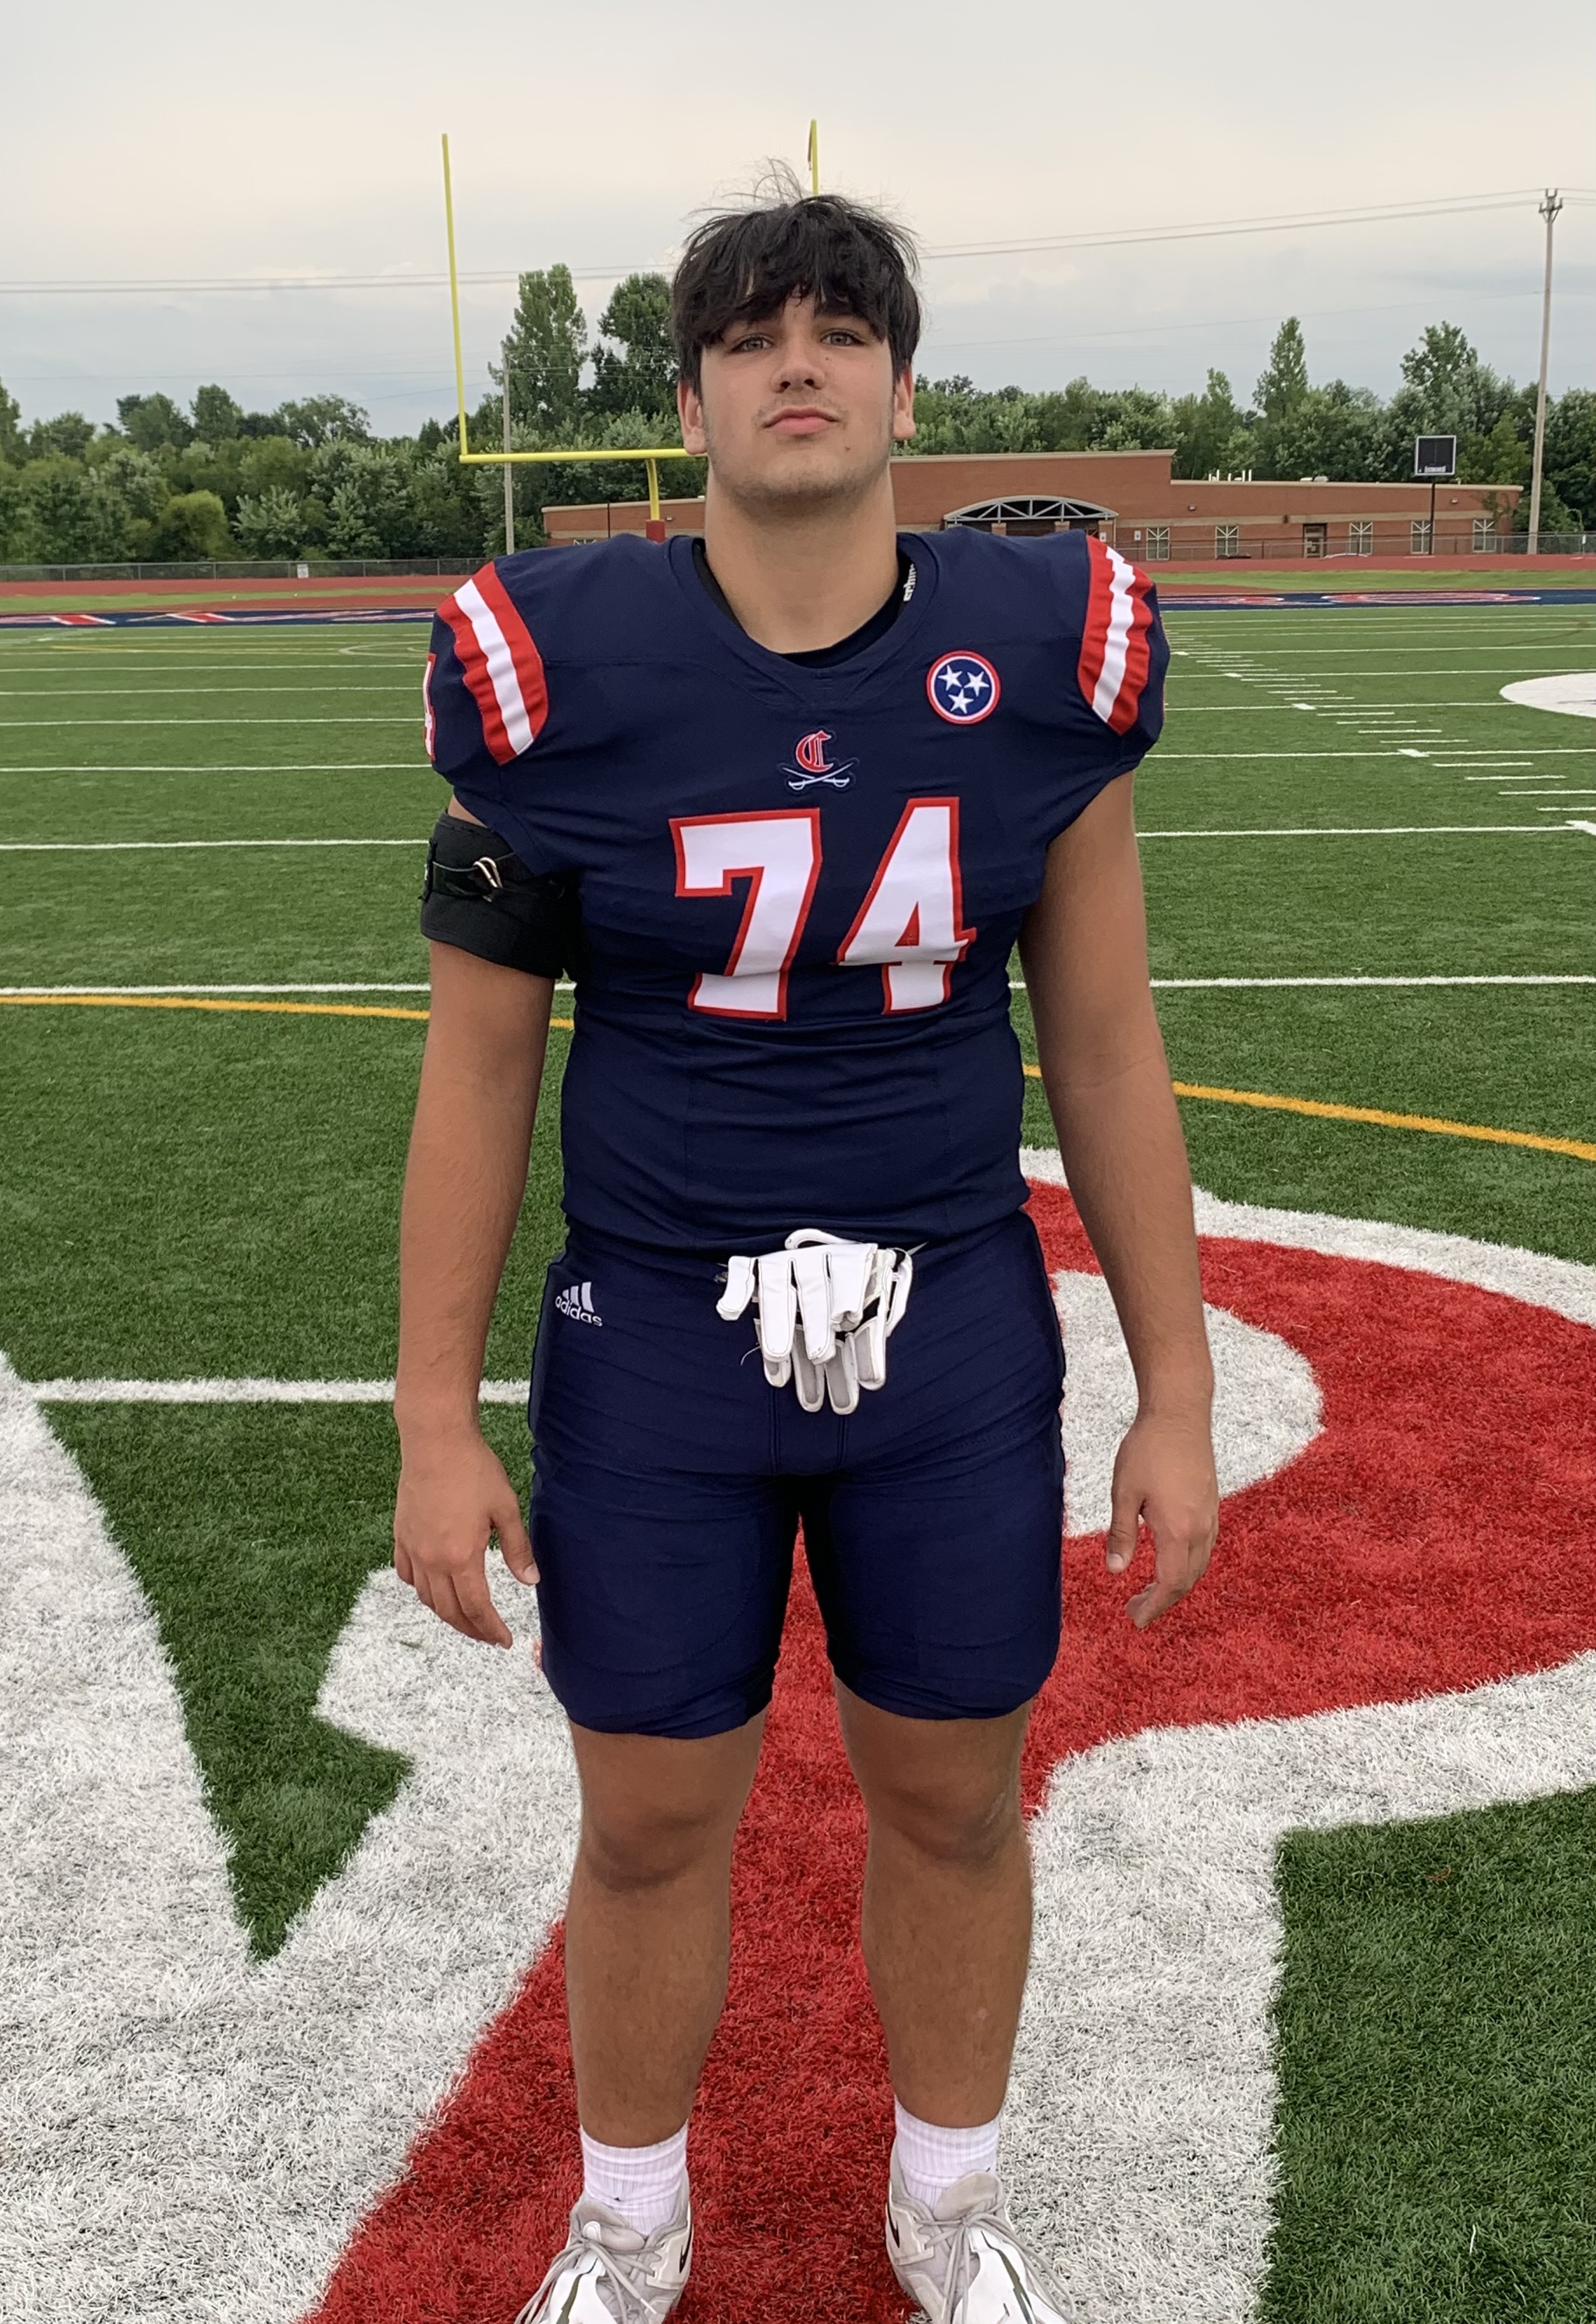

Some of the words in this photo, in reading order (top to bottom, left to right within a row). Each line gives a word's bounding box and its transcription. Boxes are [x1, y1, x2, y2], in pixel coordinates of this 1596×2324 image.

[795, 730, 834, 773] C
[669, 796, 977, 1022] 74
[555, 1296, 603, 1327] adidas
